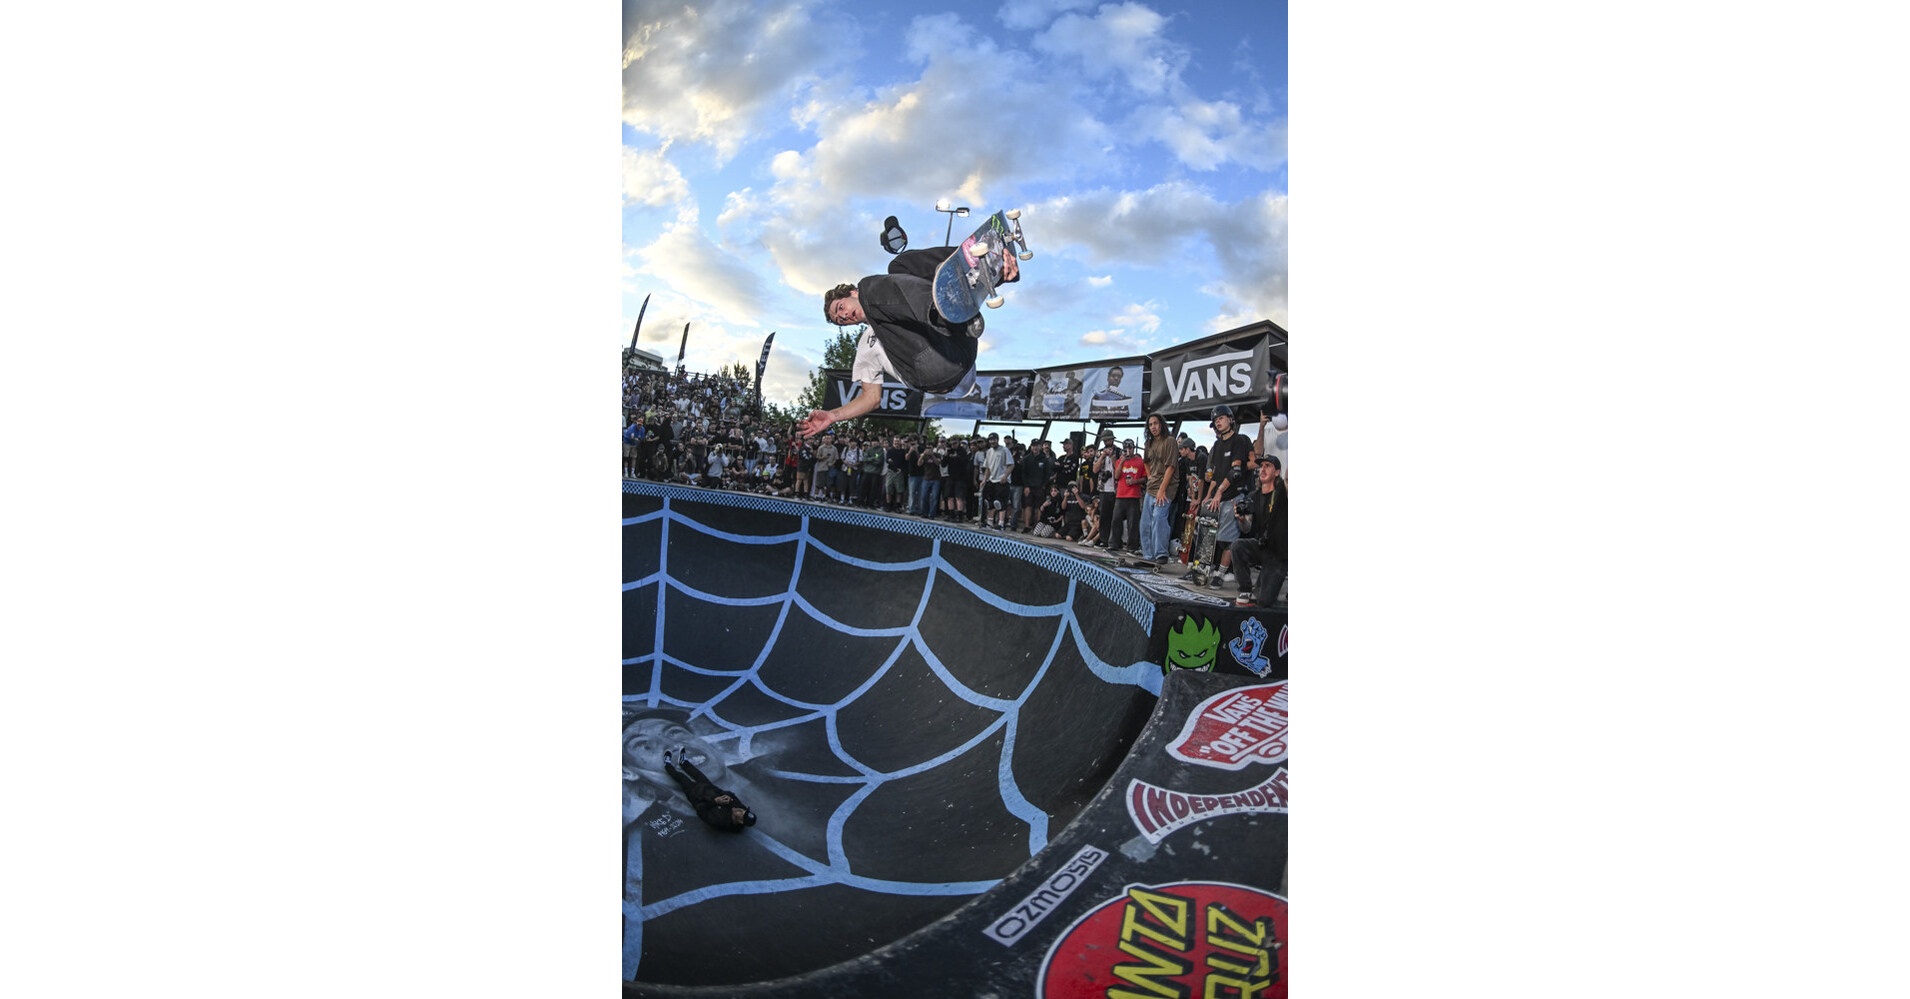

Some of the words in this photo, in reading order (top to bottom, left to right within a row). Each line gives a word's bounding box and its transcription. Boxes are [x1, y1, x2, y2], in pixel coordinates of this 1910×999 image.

[1163, 349, 1254, 404] VANS
[838, 380, 908, 410] VNS
[1203, 692, 1263, 724] VANS
[1238, 706, 1288, 735] THE
